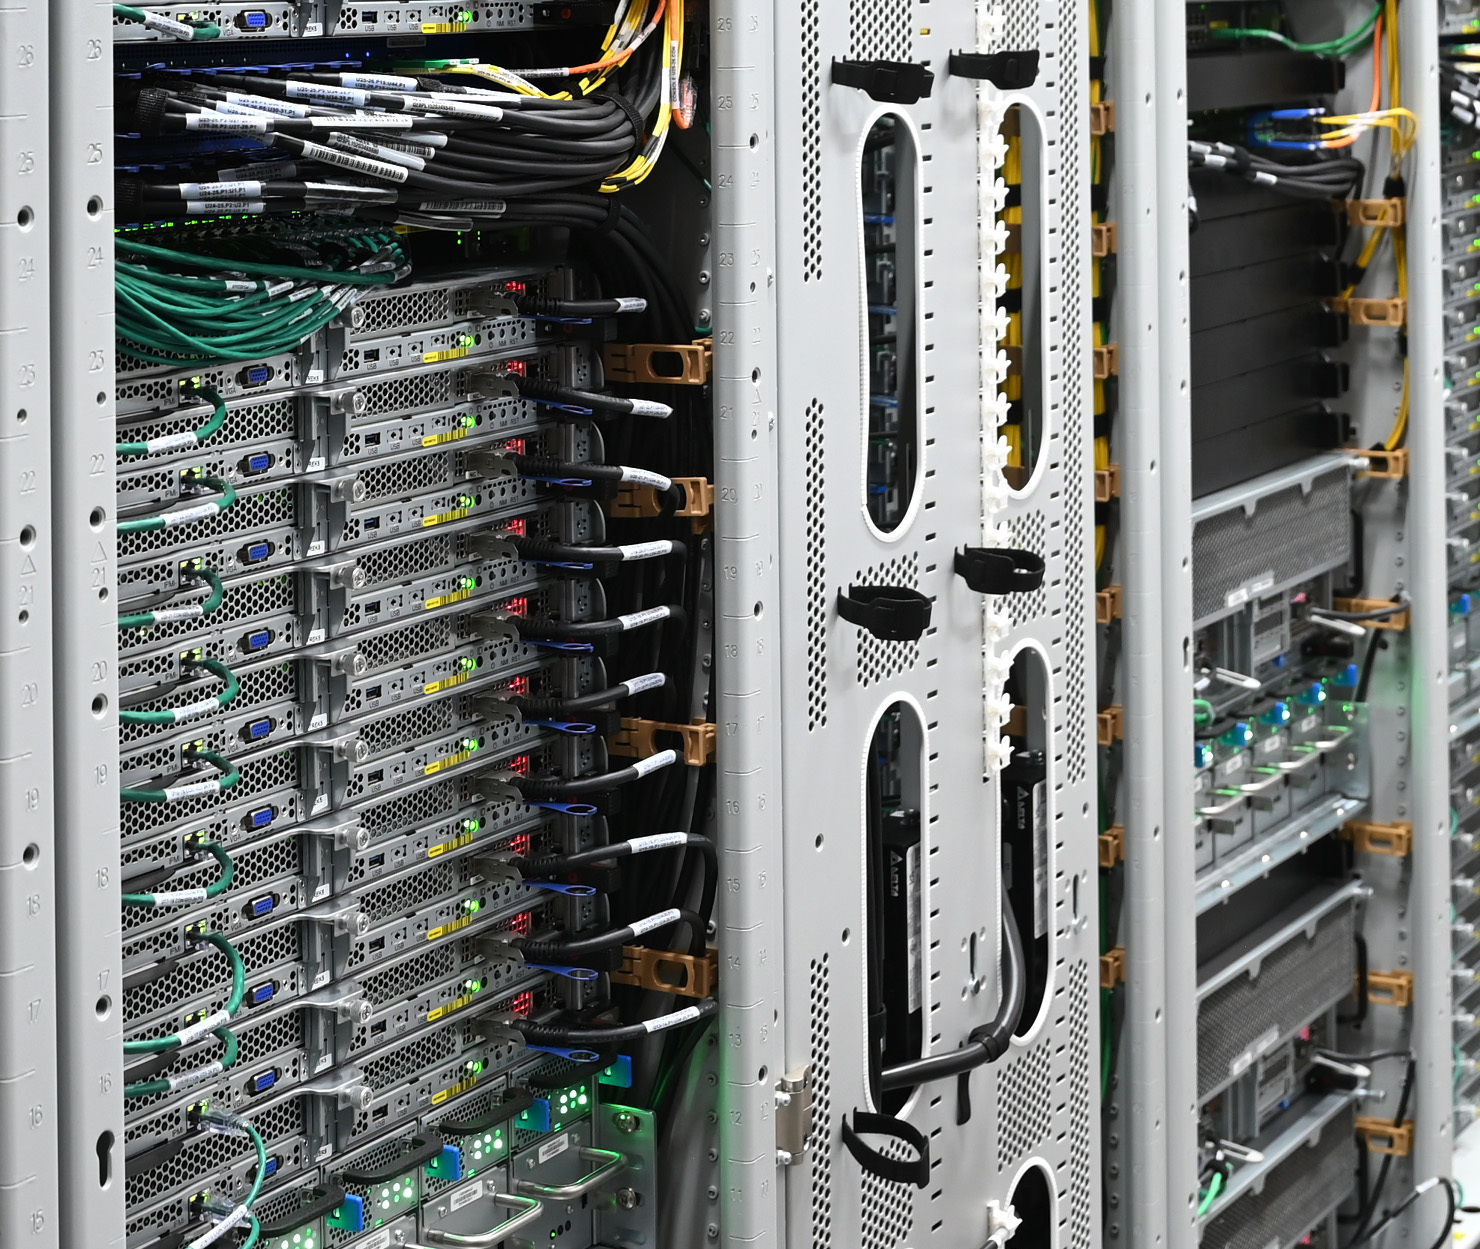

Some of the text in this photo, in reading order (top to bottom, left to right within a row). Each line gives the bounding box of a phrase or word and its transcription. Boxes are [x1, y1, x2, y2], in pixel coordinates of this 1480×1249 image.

[717, 18, 732, 31] 26
[16, 45, 34, 68] 26
[86, 39, 102, 61] 26
[718, 97, 733, 109] 25
[17, 152, 34, 175] 25
[87, 142, 103, 165] 25
[719, 174, 734, 188] 24
[18, 258, 36, 282] 24
[88, 247, 104, 270] 24
[720, 252, 734, 266] 23
[720, 331, 735, 345] 22
[88, 350, 105, 372] 23
[20, 364, 36, 388] 23
[720, 406, 733, 418] 21
[89, 453, 105, 477] 22
[20, 470, 36, 495] 22
[722, 488, 737, 501] 20
[91, 566, 105, 590] 21
[724, 565, 737, 580] 19
[20, 585, 33, 606] 21
[724, 644, 738, 657] 18
[91, 660, 108, 685] 20
[21, 682, 38, 708] 20
[726, 722, 738, 736] 17
[95, 763, 108, 787] 19
[26, 788, 40, 812] 19
[727, 801, 740, 814] 16
[96, 866, 109, 890] 18
[727, 878, 741, 892] 15
[26, 895, 40, 918] 18
[98, 969, 110, 993] 17
[28, 999, 42, 1024] 17
[99, 1072, 112, 1096] 16
[30, 1104, 43, 1130] 16
[31, 1209, 44, 1234] 15
